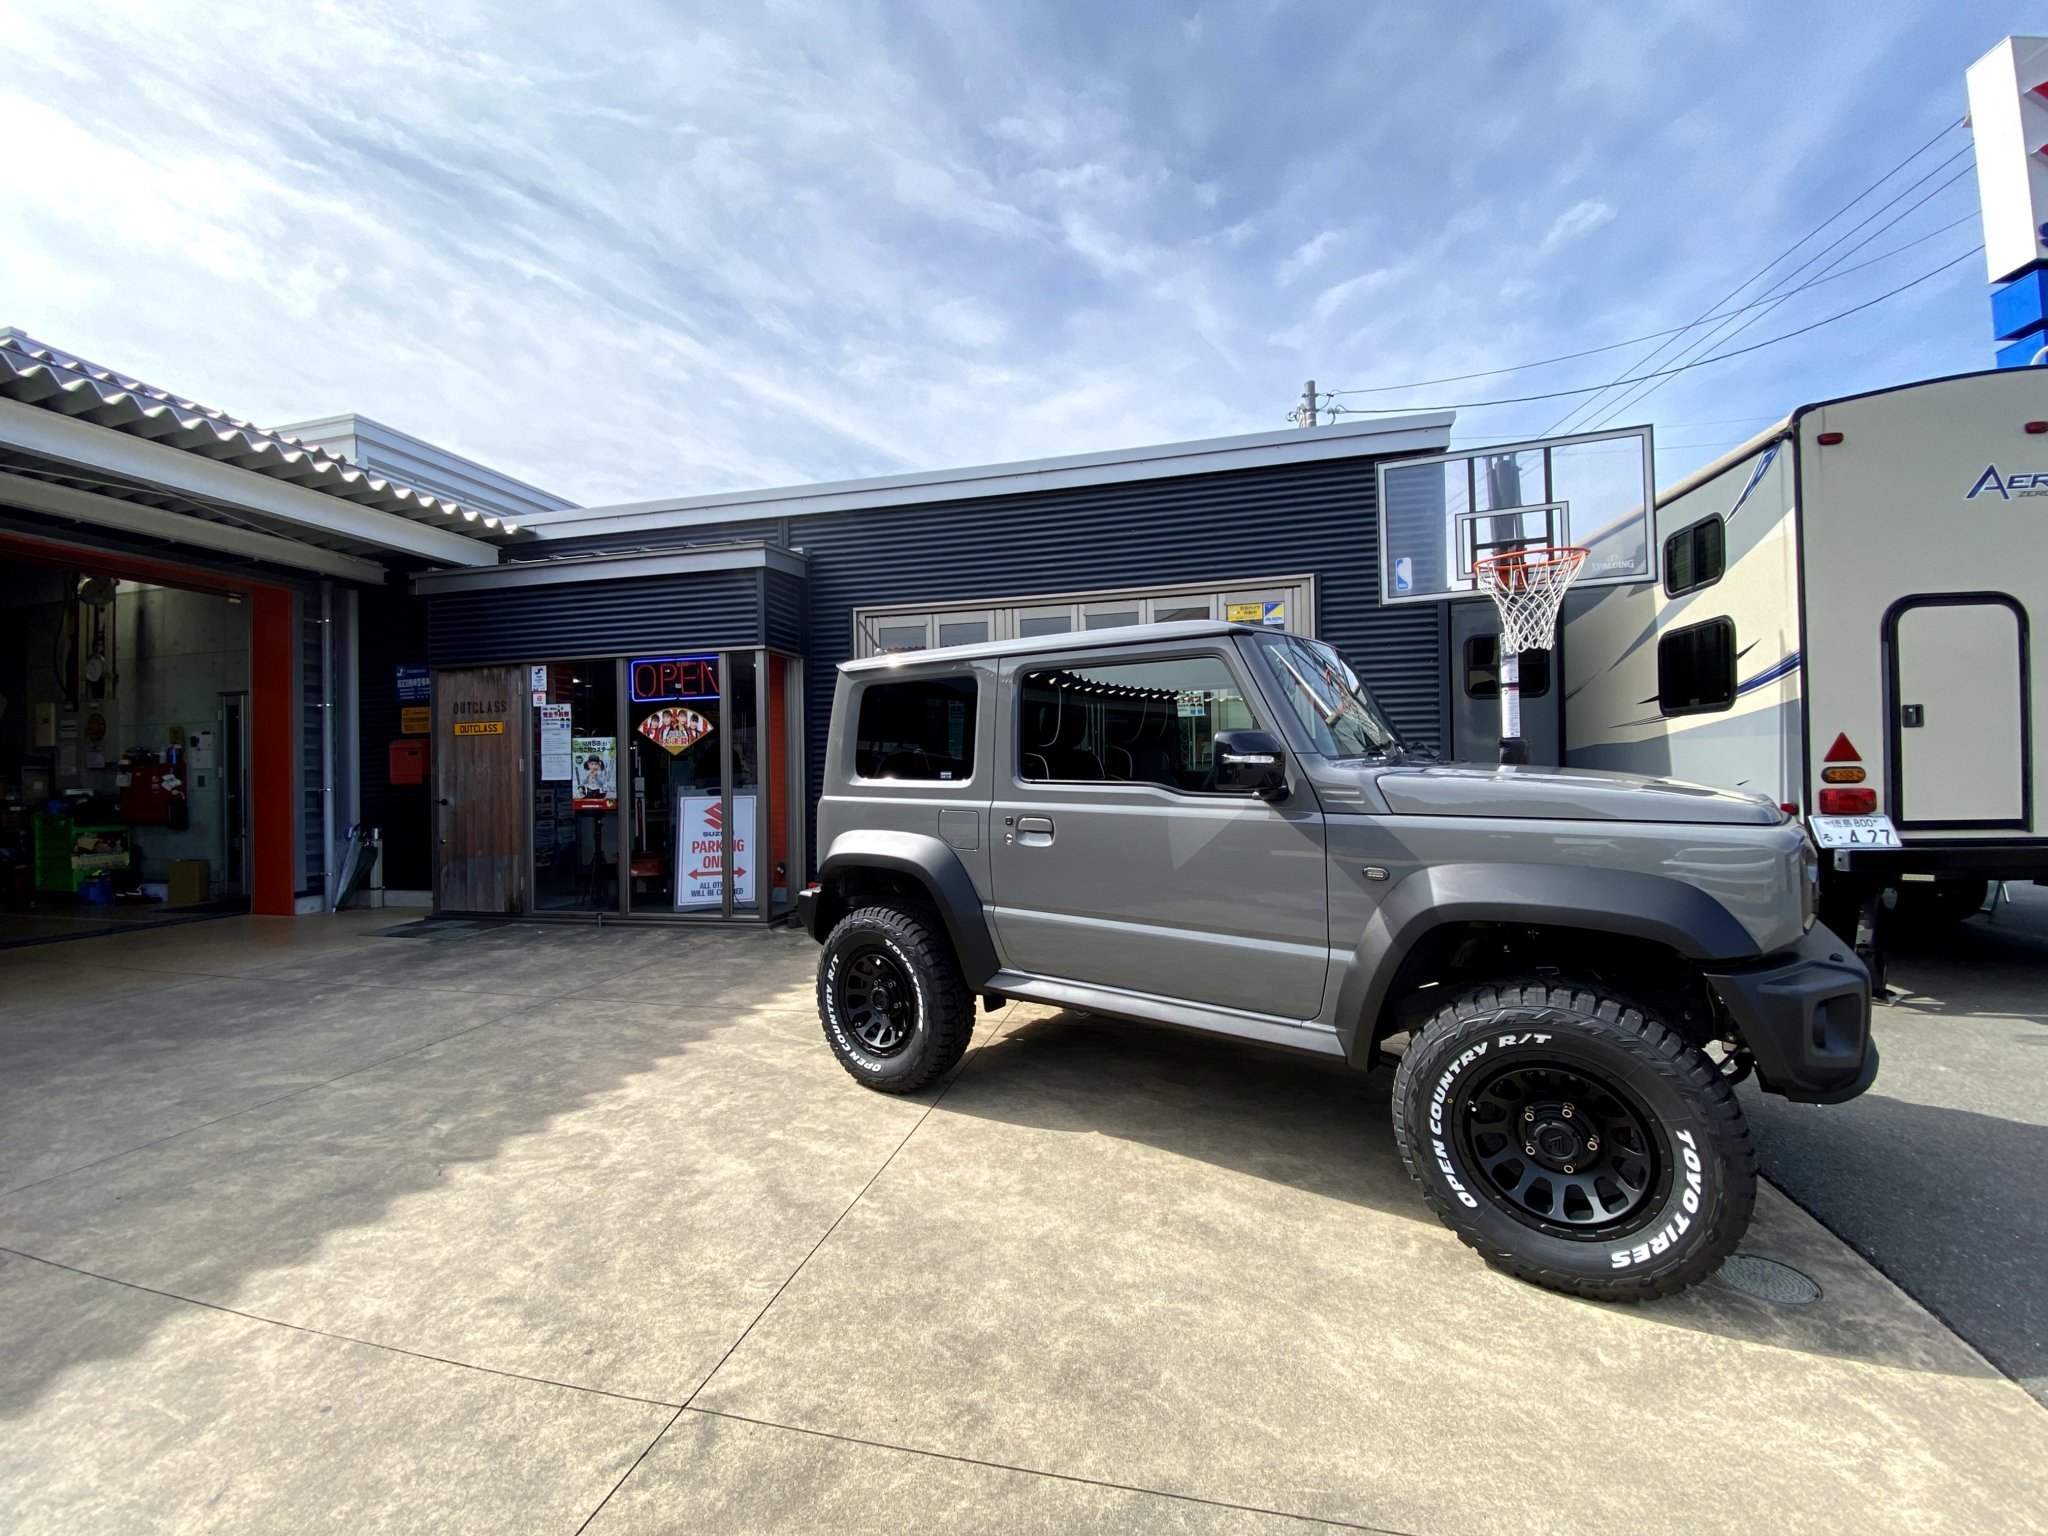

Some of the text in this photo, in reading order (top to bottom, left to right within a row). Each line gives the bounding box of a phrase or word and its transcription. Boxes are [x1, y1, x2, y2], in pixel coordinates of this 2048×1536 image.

[1592, 559, 1634, 571] SPALDING
[635, 661, 720, 697] OPEN
[453, 701, 507, 714] OUTCLASS
[460, 724, 497, 733] OUTCLASS
[826, 954, 882, 1072] OPEN COUNTRY R/T
[1429, 1033, 1552, 1209] OPEN COUNTRY R/T
[1611, 1128, 1702, 1269] TOYO TIRES
